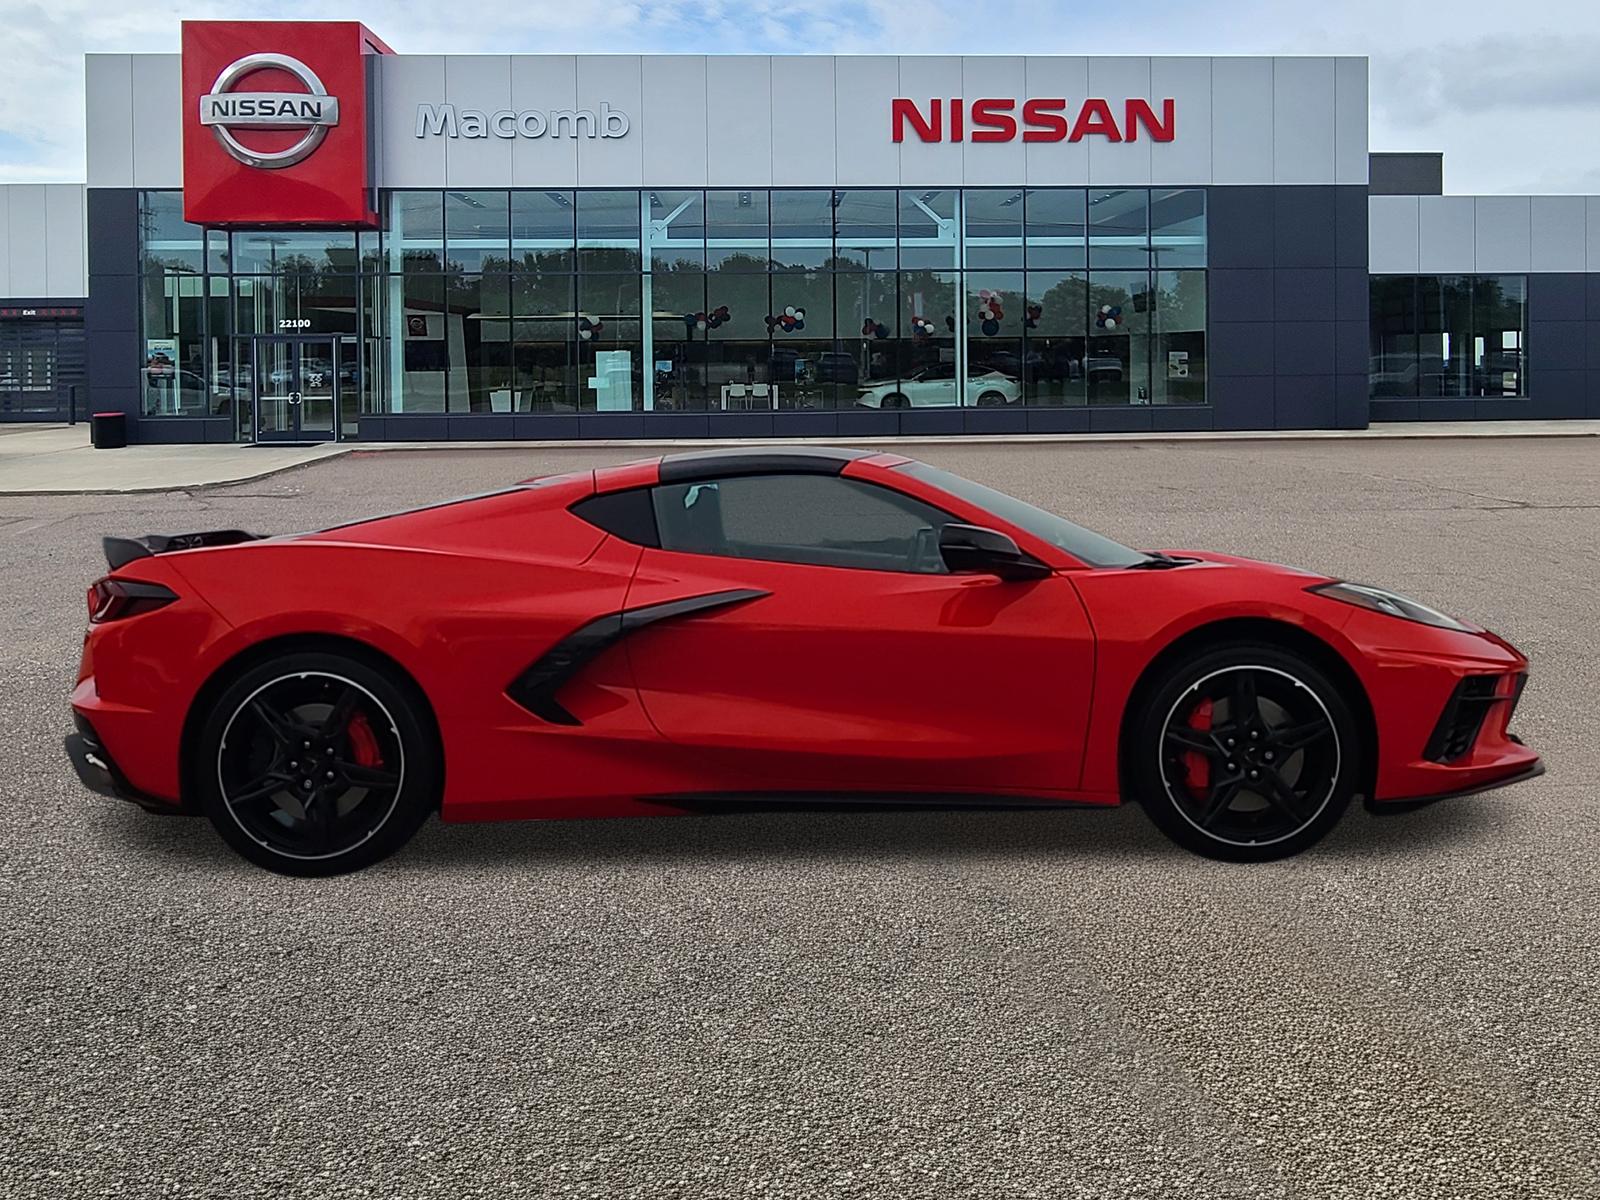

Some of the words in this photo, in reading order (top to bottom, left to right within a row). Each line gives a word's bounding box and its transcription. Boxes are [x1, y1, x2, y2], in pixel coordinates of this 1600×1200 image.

[212, 100, 322, 117] NISSAN
[415, 102, 630, 138] Macomb
[892, 98, 1175, 142] NISSAN
[279, 319, 311, 328] 22100
